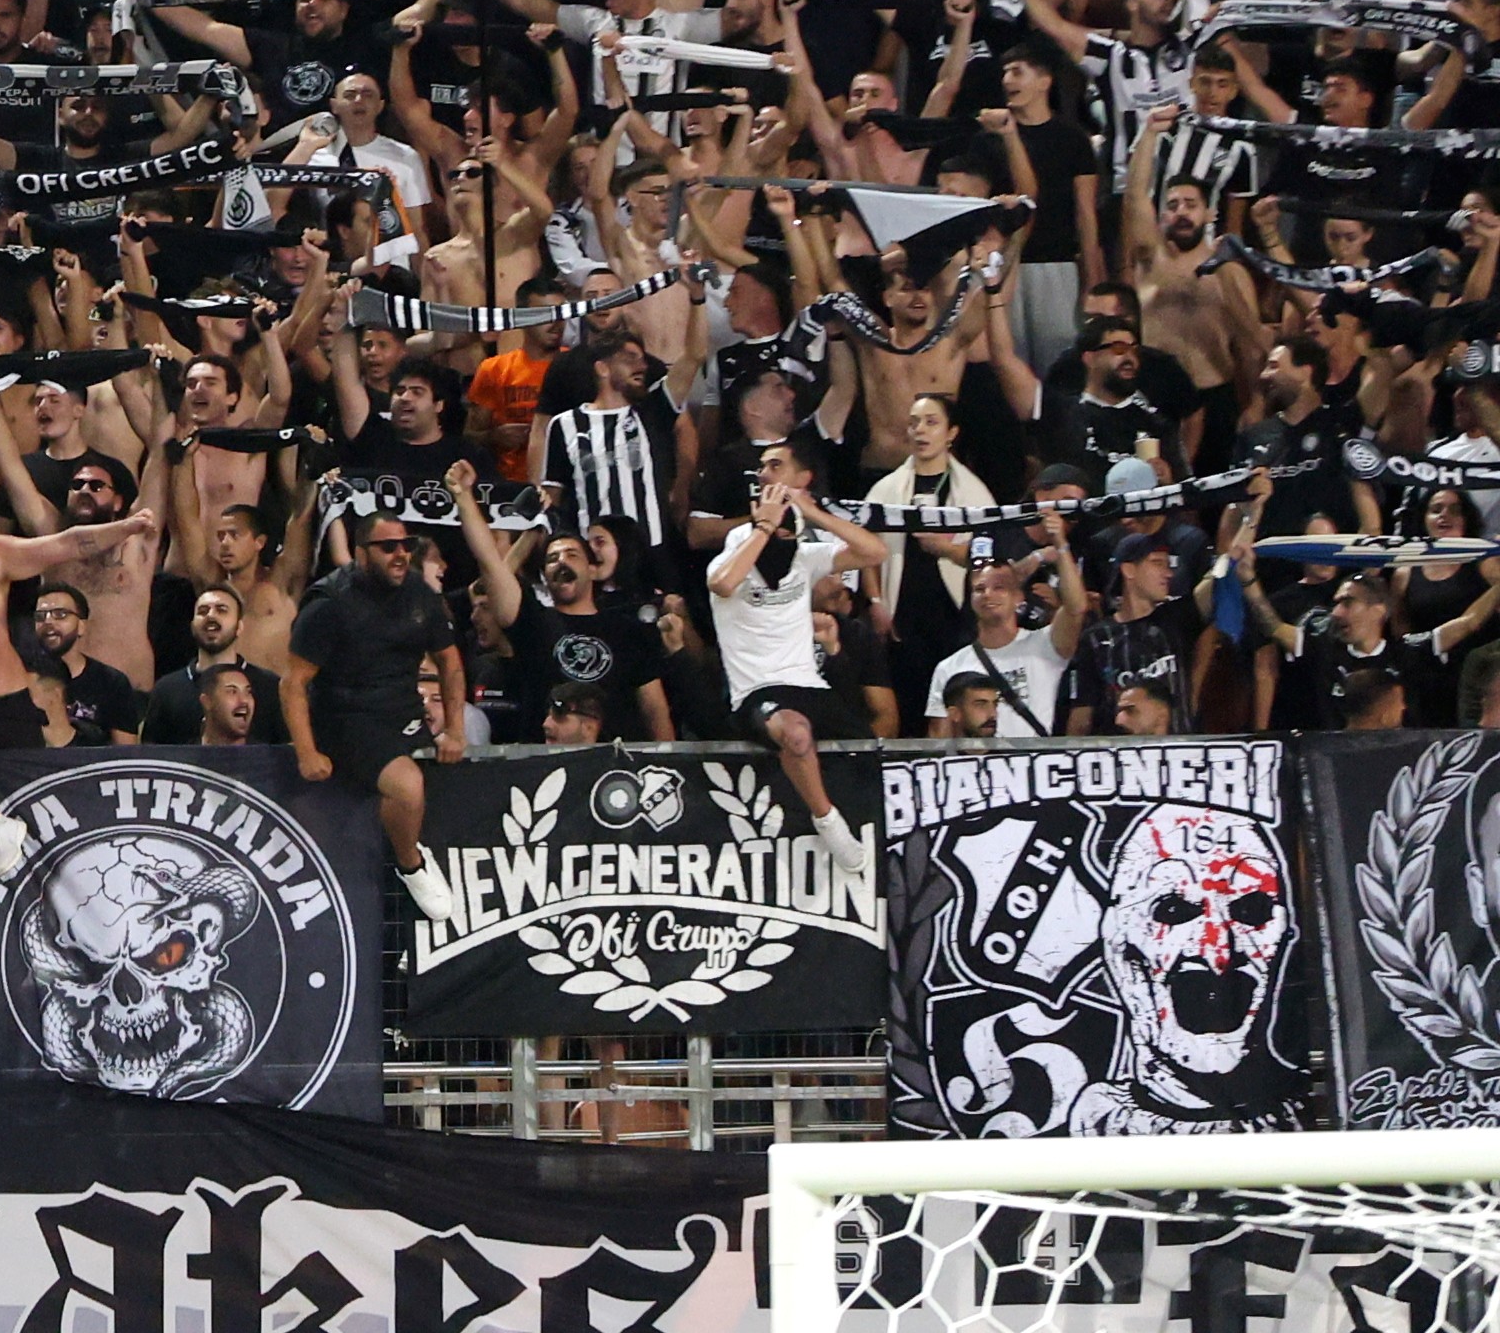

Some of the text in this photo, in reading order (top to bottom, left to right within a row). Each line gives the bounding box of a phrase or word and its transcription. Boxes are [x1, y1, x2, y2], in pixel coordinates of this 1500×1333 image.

[16, 140, 220, 198] OFI CRETE FC
[1383, 458, 1462, 488] ΟΦΗ
[884, 740, 1283, 839] BIANCONERI
[99, 778, 333, 932] TRIADA
[1176, 822, 1238, 857] 184
[561, 822, 877, 929] GENERATION
[646, 910, 760, 969] Gruppo
